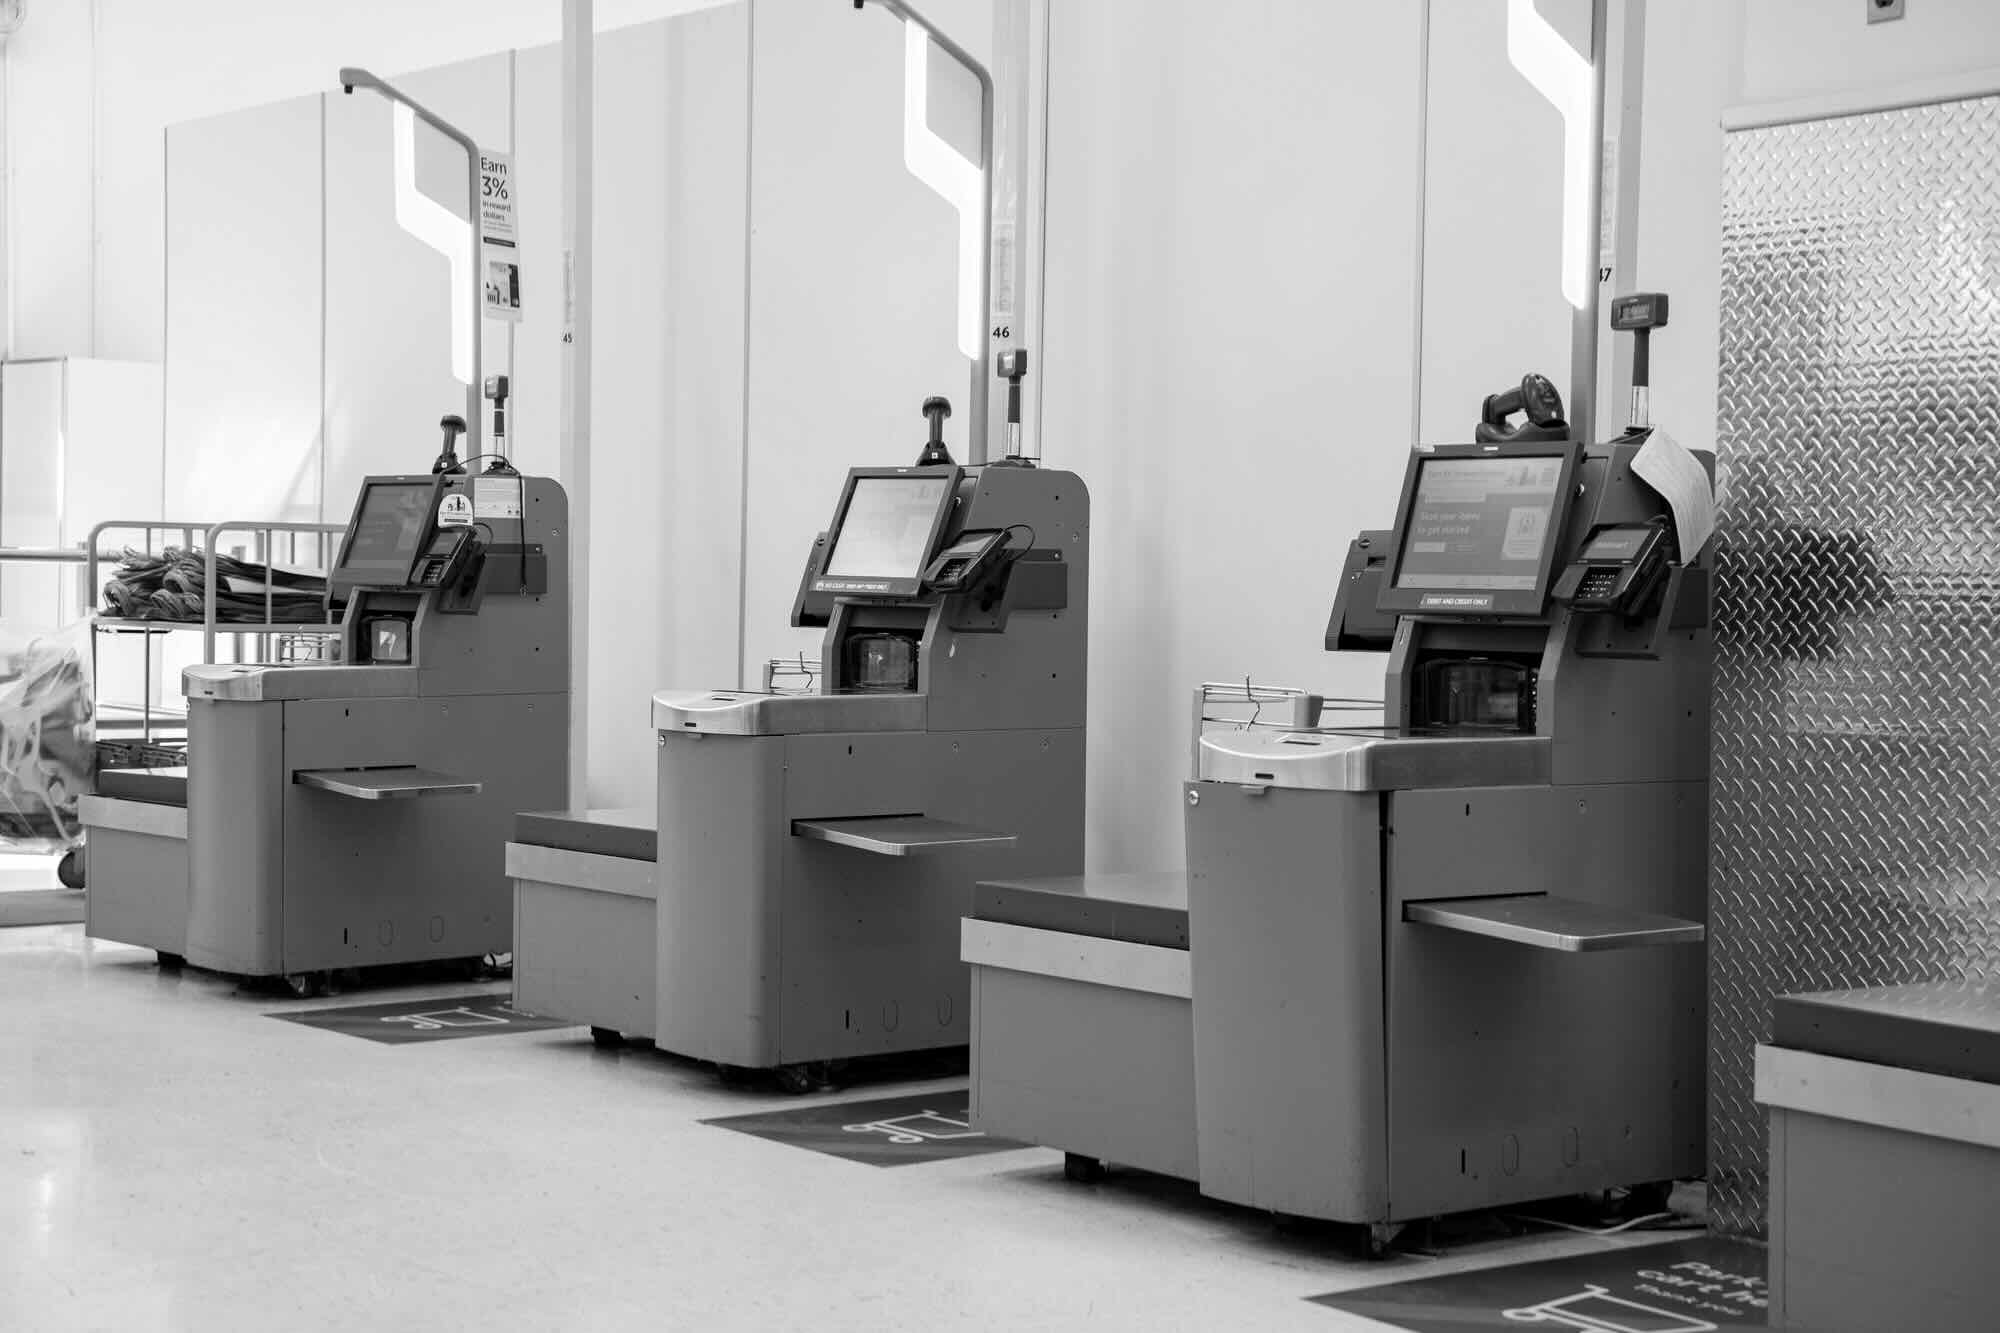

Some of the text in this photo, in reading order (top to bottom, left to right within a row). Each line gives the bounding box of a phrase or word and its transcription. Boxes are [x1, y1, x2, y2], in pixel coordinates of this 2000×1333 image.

[481, 157, 507, 175] Earn
[482, 175, 508, 200] 3%
[563, 332, 573, 344] 45
[992, 326, 1010, 338] 46
[1721, 1289, 1768, 1308] he
